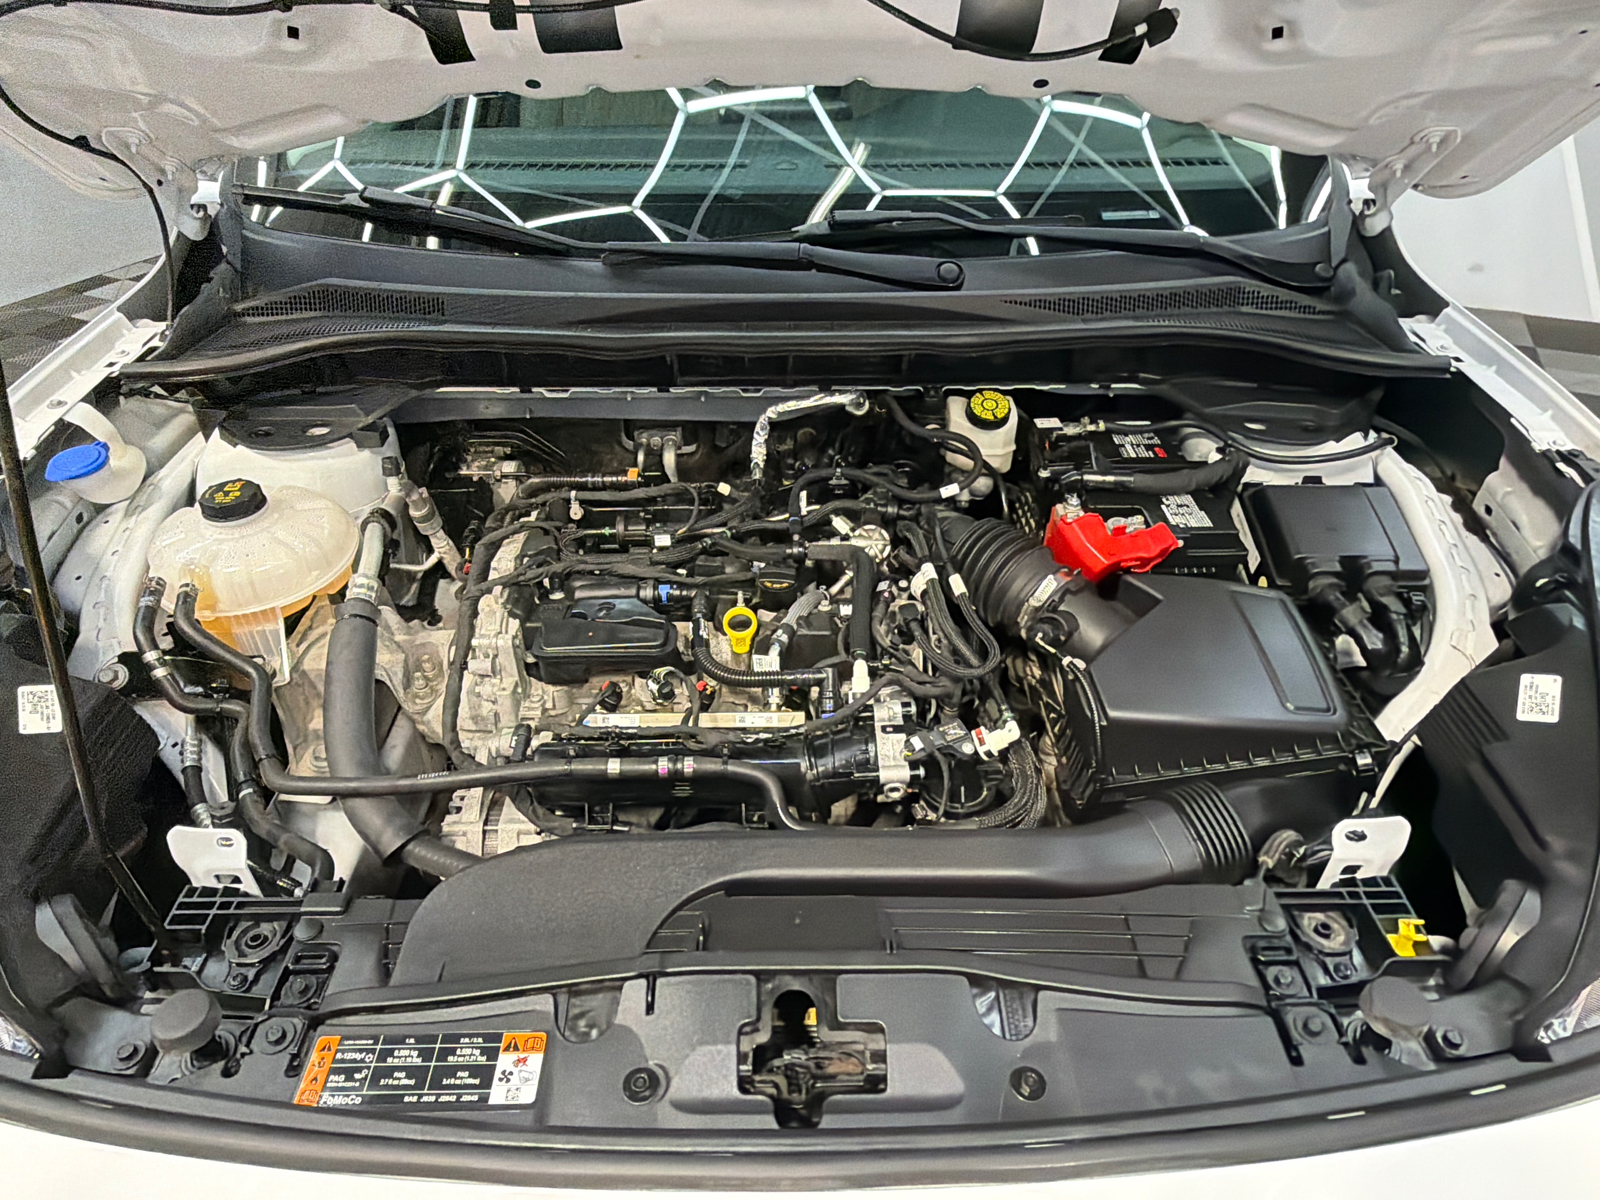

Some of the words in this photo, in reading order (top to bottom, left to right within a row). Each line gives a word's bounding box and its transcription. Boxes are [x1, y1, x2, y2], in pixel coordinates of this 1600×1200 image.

[410, 1050, 418, 1058] kg
[472, 1048, 480, 1056] kg
[336, 1052, 366, 1061] R-1234yf
[319, 1094, 362, 1105] FoMoCo
